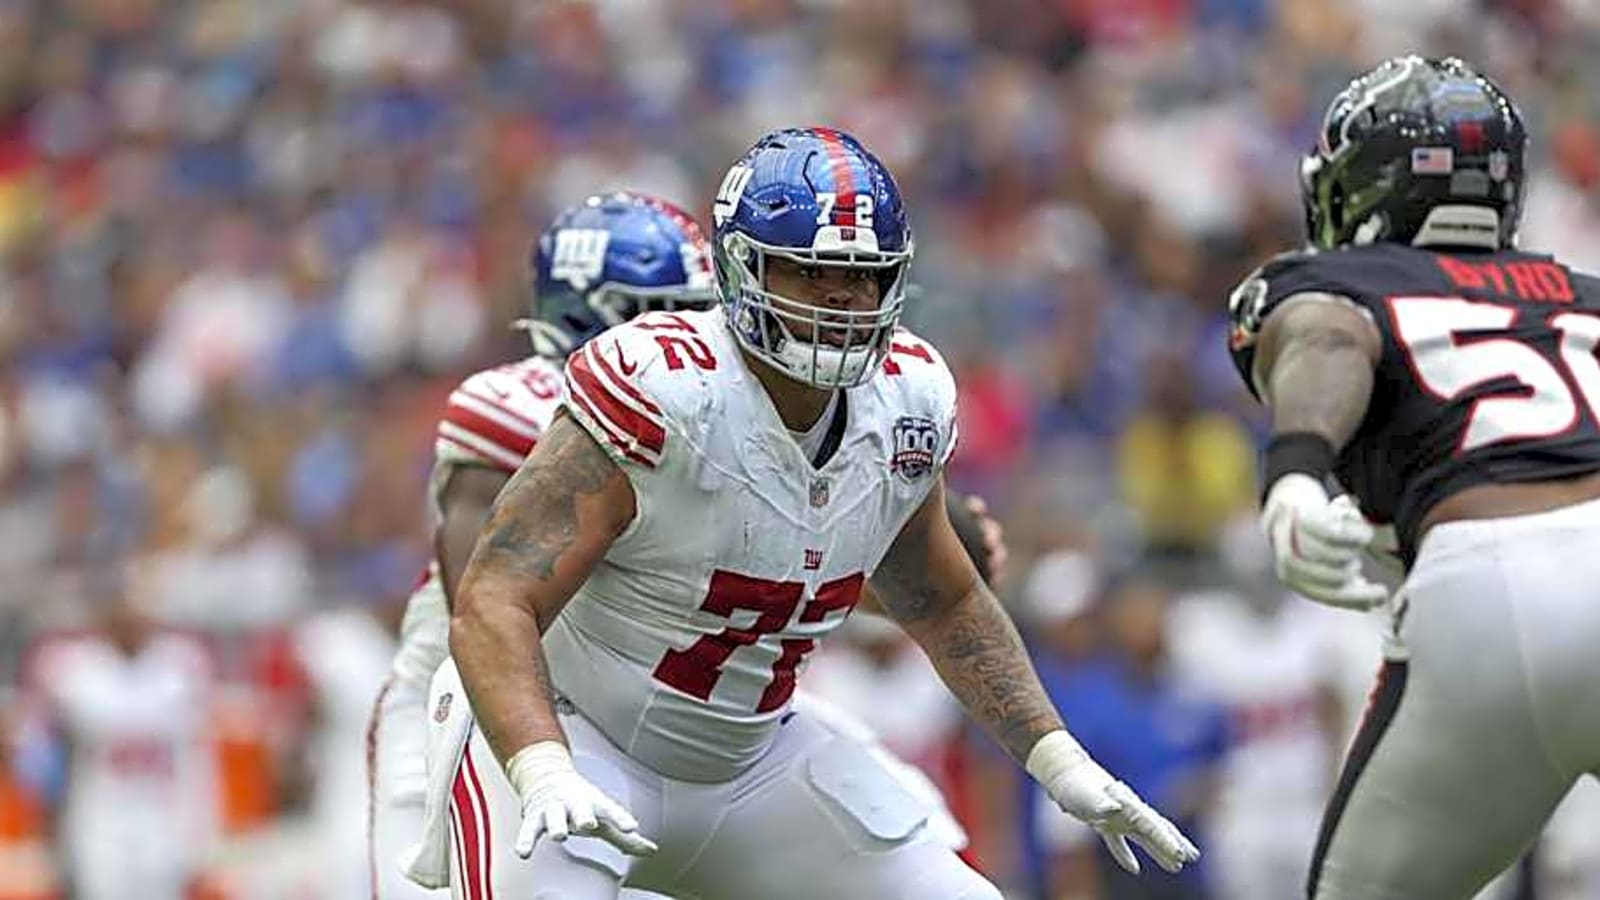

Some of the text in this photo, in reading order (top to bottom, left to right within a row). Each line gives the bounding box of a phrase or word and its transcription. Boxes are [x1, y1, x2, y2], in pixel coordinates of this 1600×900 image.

[1436, 255, 1575, 303] BYRD
[1382, 296, 1600, 455] 5
[895, 429, 938, 452] 100
[652, 567, 865, 714] 72
